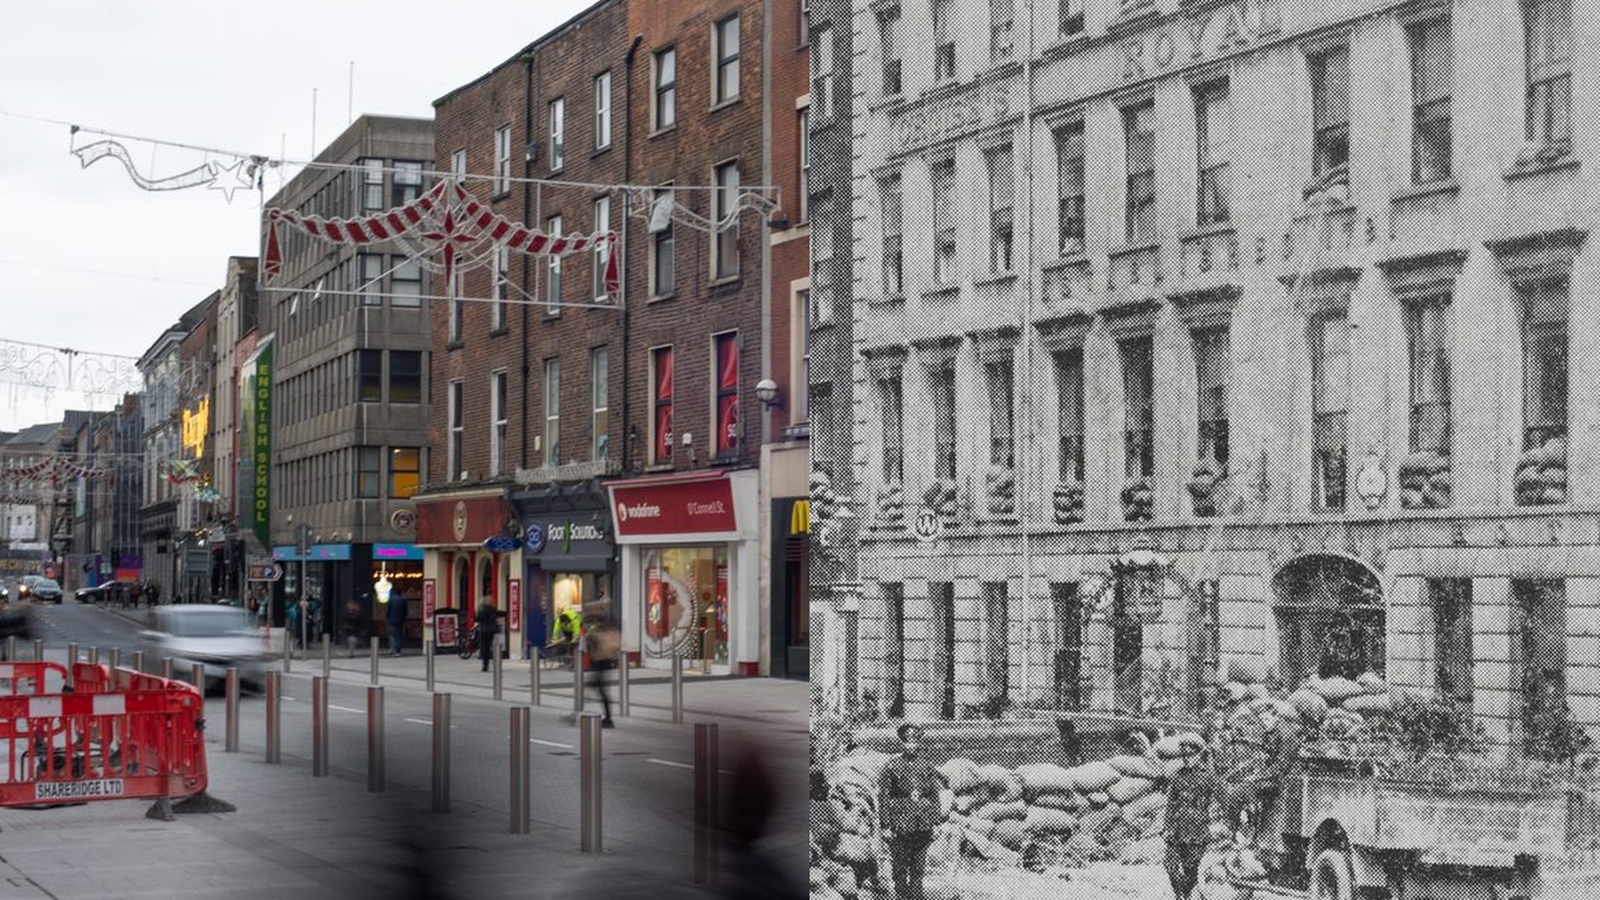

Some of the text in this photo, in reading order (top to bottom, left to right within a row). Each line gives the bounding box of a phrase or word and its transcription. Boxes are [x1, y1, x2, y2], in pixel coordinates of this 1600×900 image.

[256, 364, 269, 522] ENGLISH SCHOOL
[628, 501, 661, 519] vodafone
[37, 779, 122, 799] SHARERIDGE LTD
